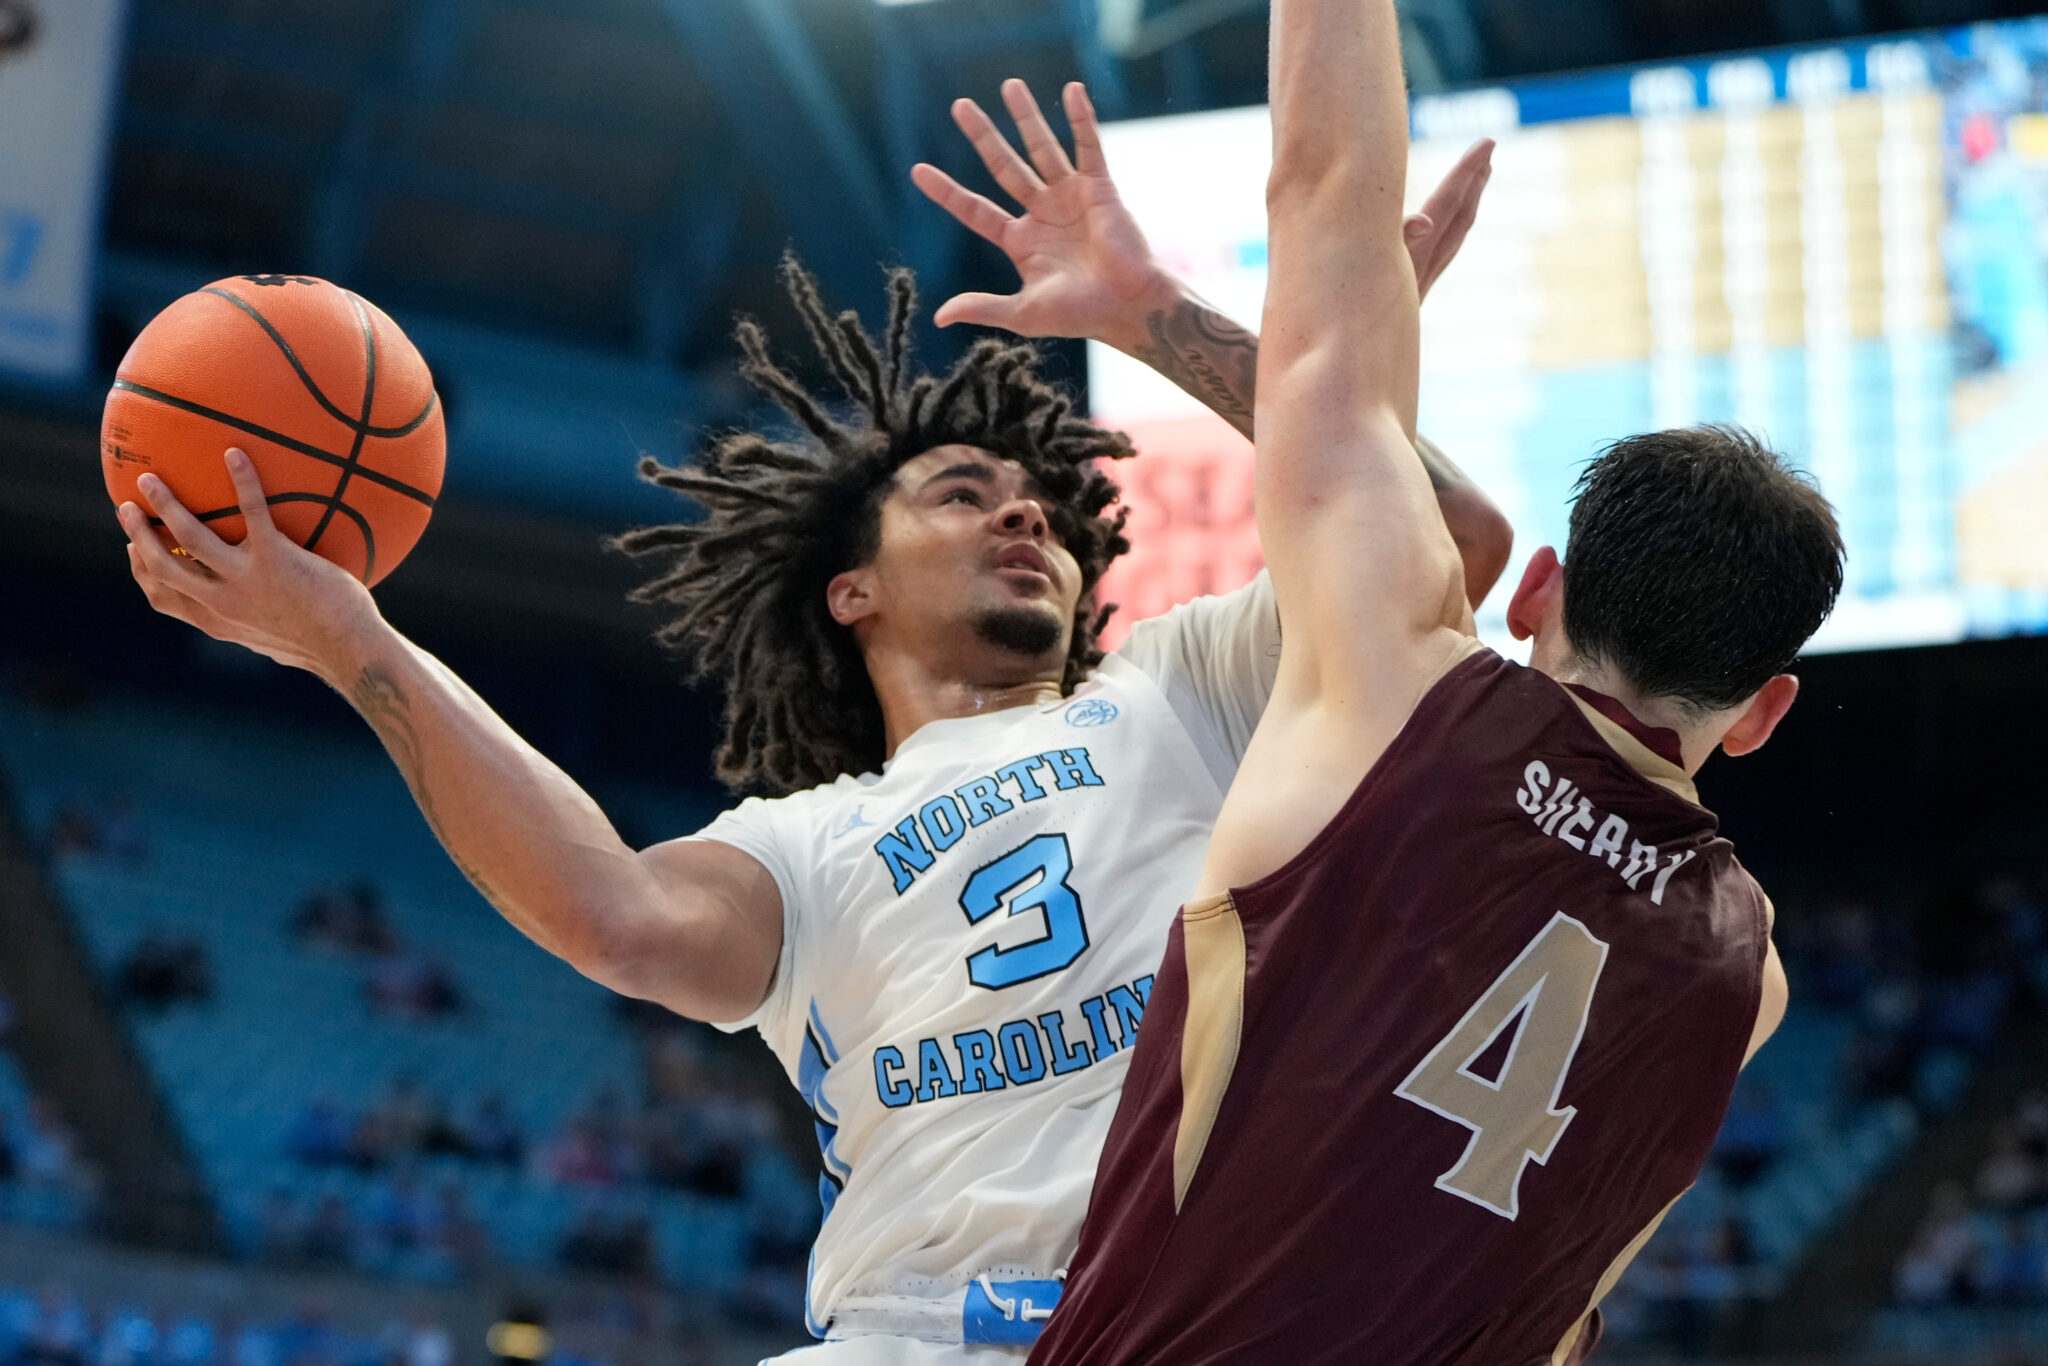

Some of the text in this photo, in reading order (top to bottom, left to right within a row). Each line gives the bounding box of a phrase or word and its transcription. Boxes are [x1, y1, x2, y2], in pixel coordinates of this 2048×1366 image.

[874, 747, 1105, 896] NORTH
[958, 833, 1090, 991] 3
[1393, 910, 1610, 1221] 4
